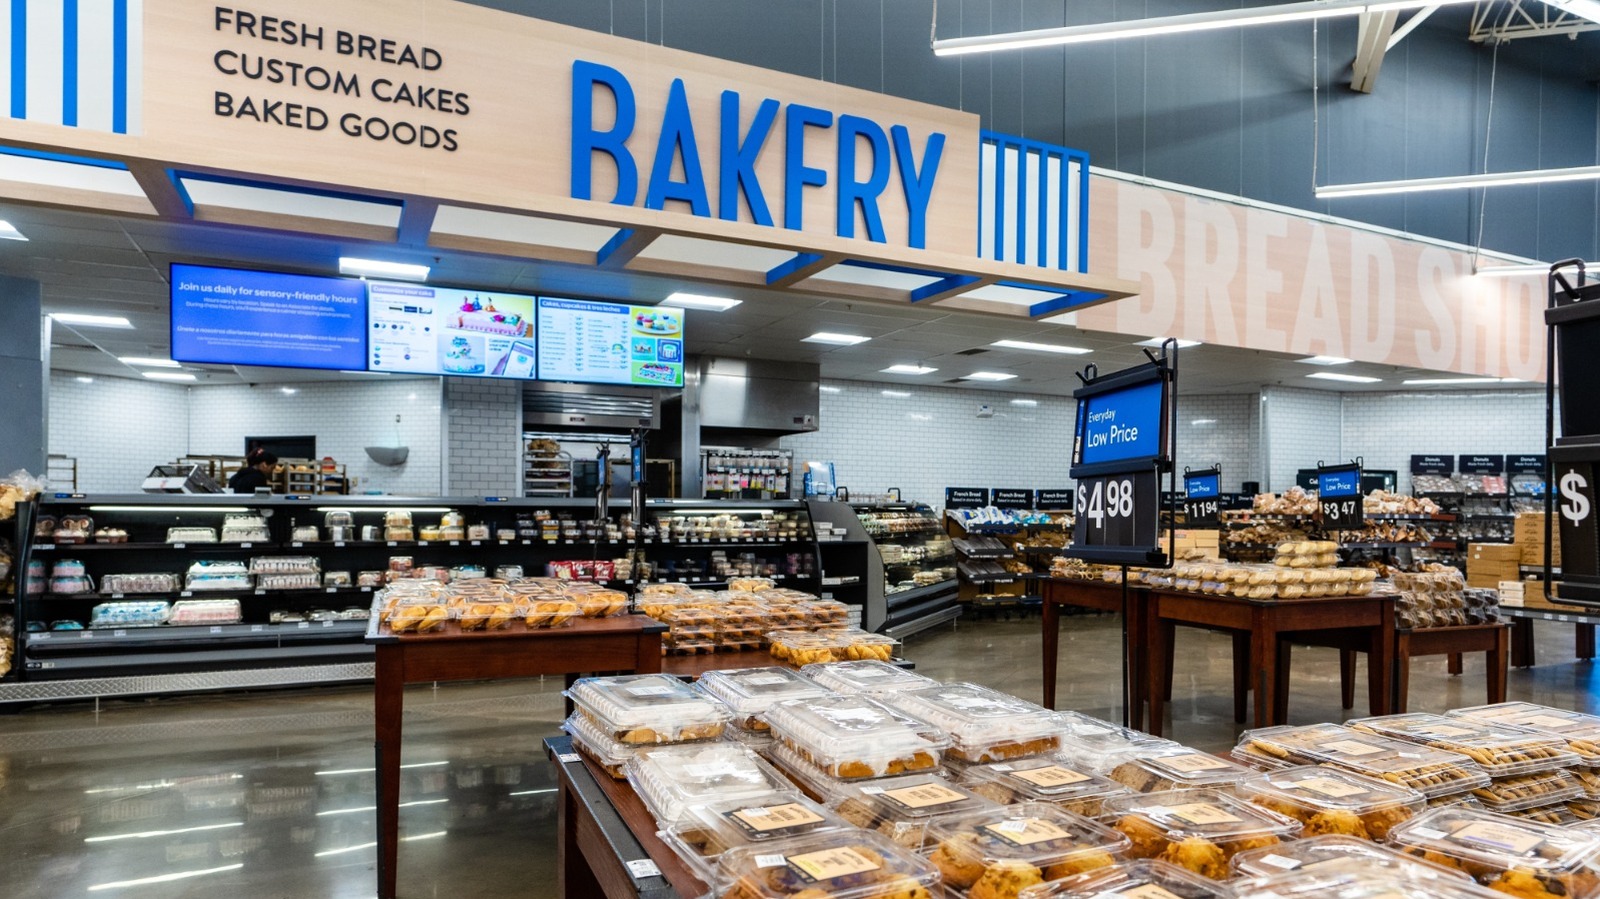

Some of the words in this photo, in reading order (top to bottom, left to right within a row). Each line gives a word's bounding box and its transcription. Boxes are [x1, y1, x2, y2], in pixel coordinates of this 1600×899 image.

[214, 6, 324, 51] FRESH
[336, 32, 443, 72] BREAD
[214, 49, 361, 98] CUSTOM
[371, 78, 470, 116] CAKES
[214, 92, 328, 131] BAKED
[339, 112, 459, 152] GOODS
[570, 60, 946, 251] BAKERY
[178, 281, 199, 291] Join
[201, 284, 213, 293] us
[214, 284, 237, 297] daily
[239, 286, 253, 296] for
[254, 289, 331, 303] sensory-friendly
[332, 294, 358, 304] hours
[561, 302, 586, 310] cupcakes
[1116, 181, 1396, 364] BREAD
[1416, 243, 1586, 383] SHO
[1088, 408, 1116, 424] Everyday
[1088, 430, 1108, 448] Low
[1110, 424, 1138, 444] Price
[1560, 468, 1590, 527] $
